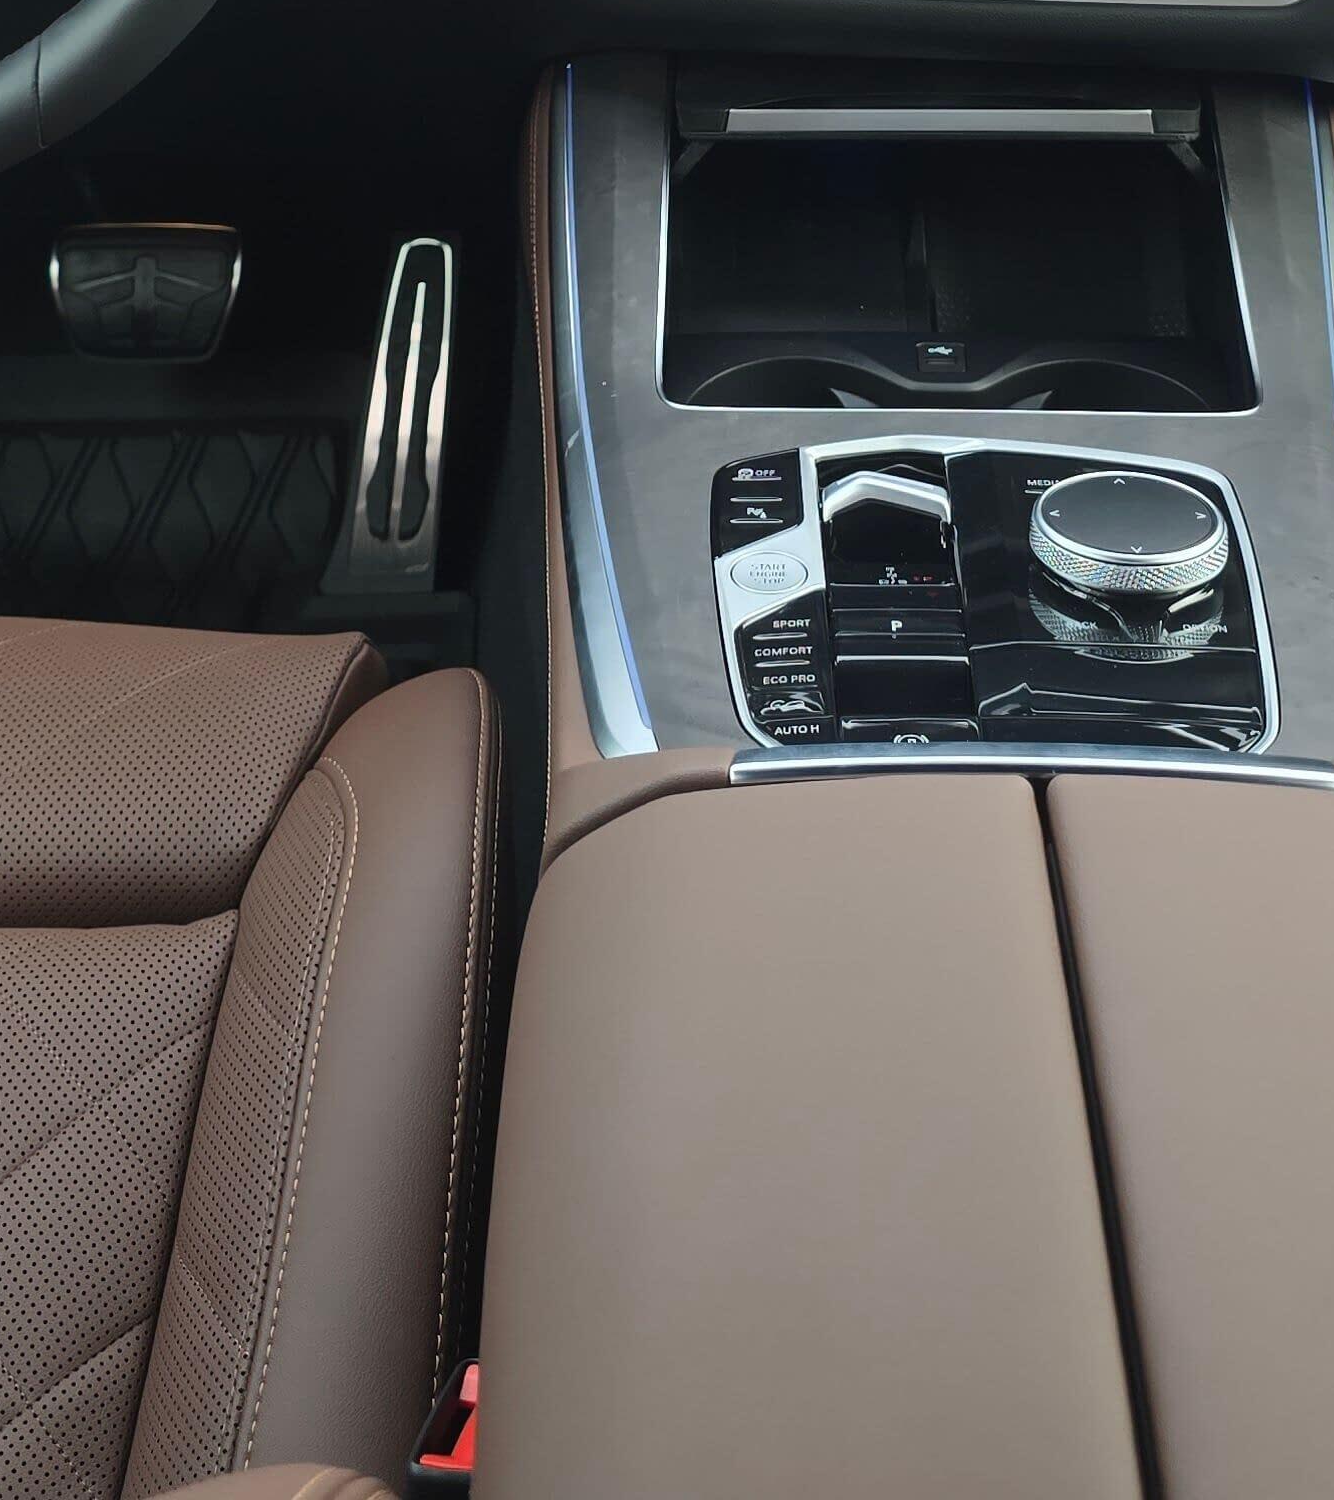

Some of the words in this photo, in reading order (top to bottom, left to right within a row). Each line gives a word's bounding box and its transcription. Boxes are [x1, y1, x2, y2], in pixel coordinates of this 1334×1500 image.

[754, 469, 777, 477] OFF
[773, 619, 811, 629] SPORT
[890, 620, 903, 631] P
[754, 646, 813, 657] COMFORT
[762, 676, 788, 685] ECO
[790, 674, 816, 684] PRO
[774, 725, 808, 736] AUTO
[810, 724, 820, 734] H
